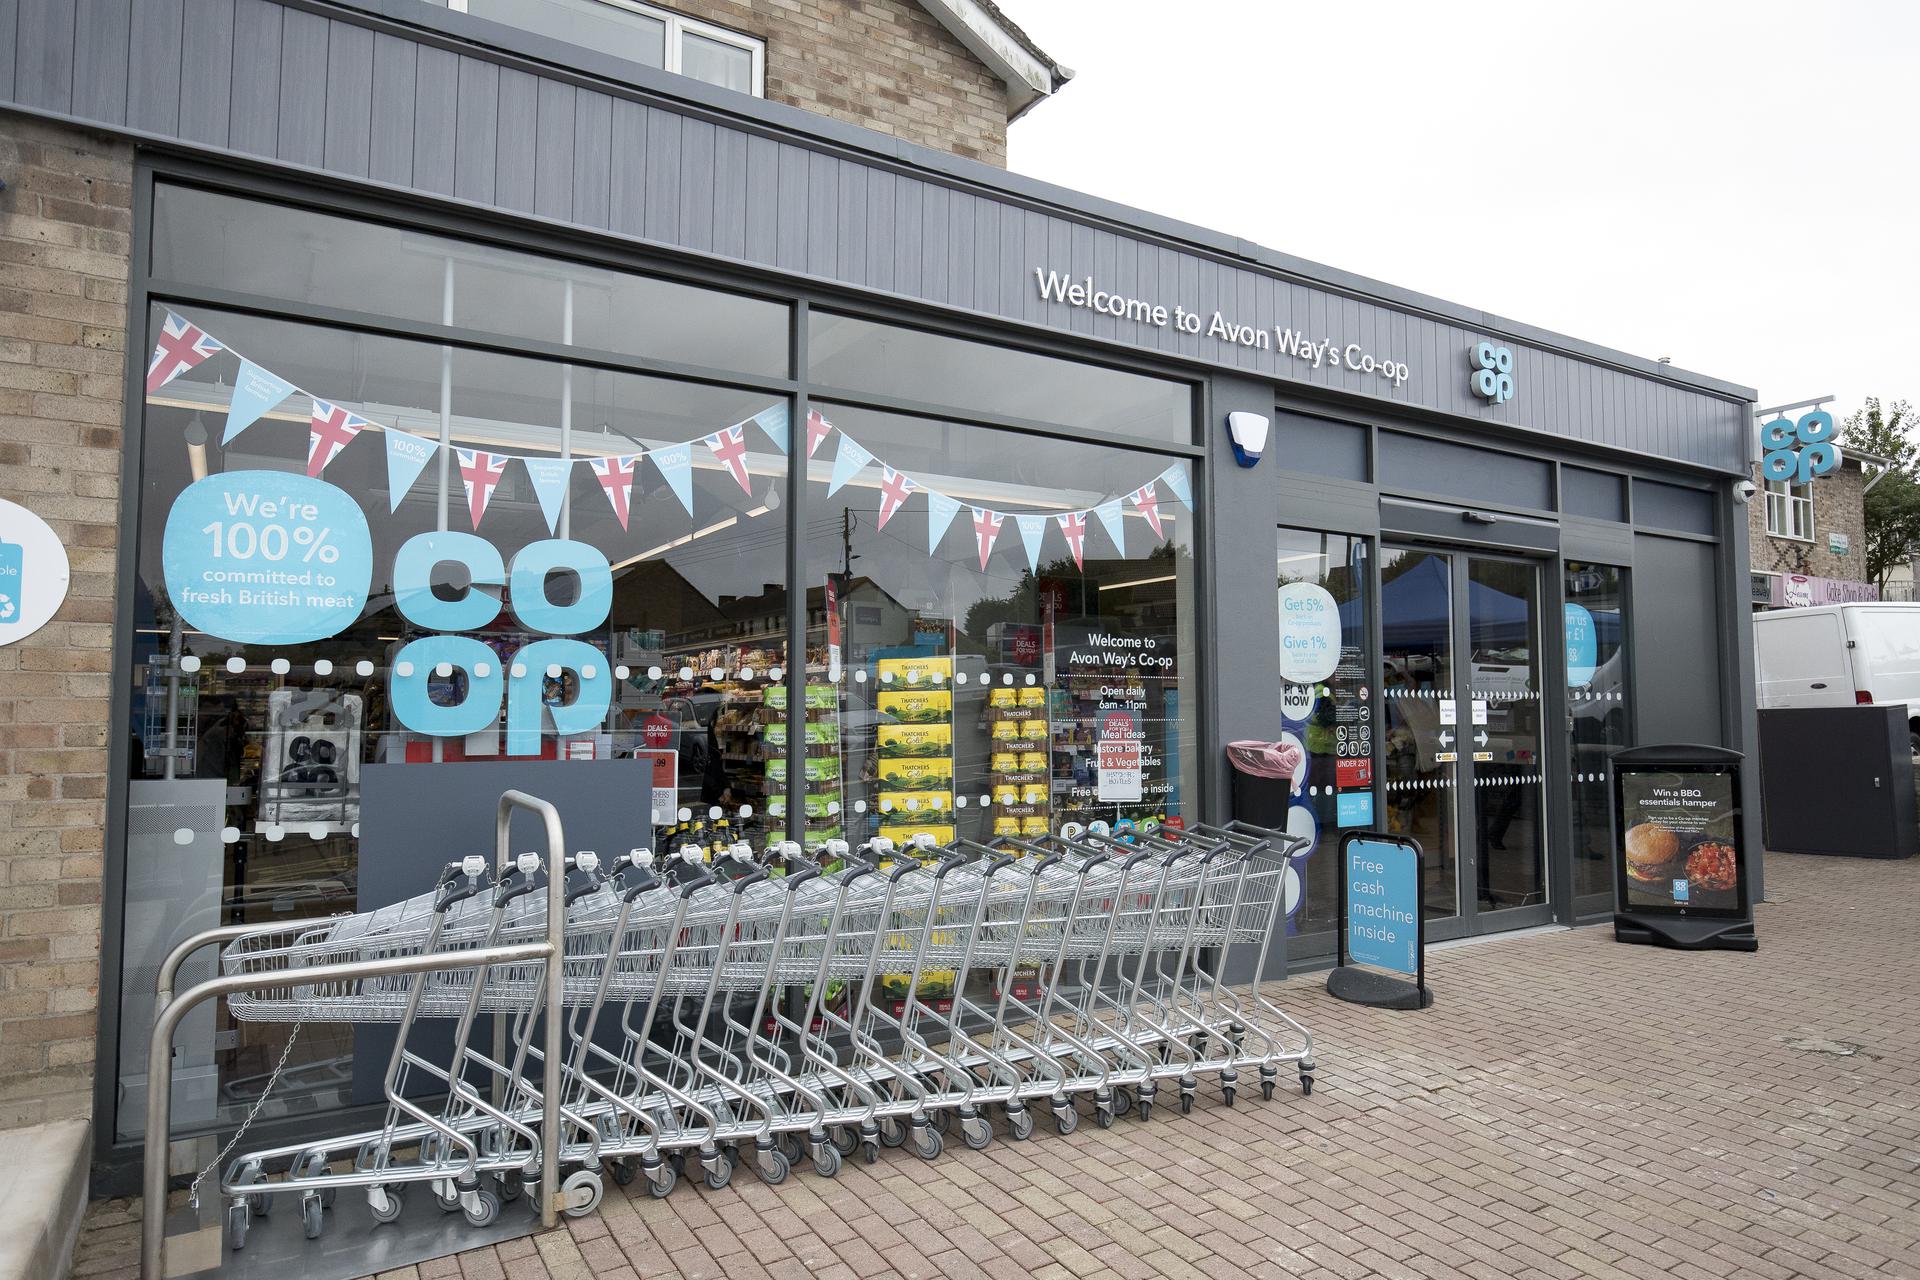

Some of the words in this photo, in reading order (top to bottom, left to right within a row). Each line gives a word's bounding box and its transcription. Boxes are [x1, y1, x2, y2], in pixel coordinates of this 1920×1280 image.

[1036, 266, 1168, 327] Welcome
[1175, 305, 1201, 334] to
[1206, 311, 1269, 350] Avon
[1275, 325, 1340, 369] Way's
[1344, 343, 1409, 387] Co-op
[394, 440, 426, 458] 100%
[223, 491, 319, 521] We're
[201, 520, 340, 564] 100%
[202, 568, 312, 587] committed
[316, 573, 336, 587] to
[181, 586, 233, 604] fresh
[239, 588, 300, 607] British
[306, 593, 355, 608] meat
[1752, 587, 1770, 600] eaway
[1284, 597, 1304, 612] Get
[1306, 598, 1324, 612] 5%
[1016, 640, 1036, 648] DEALS
[1088, 633, 1142, 648] Welcome
[1144, 637, 1156, 649] to
[1283, 635, 1308, 649] Give
[1310, 635, 1327, 649] 1%
[1069, 651, 1100, 665] Avon
[1102, 652, 1137, 669] Way's
[1138, 652, 1173, 670] Co-op
[1099, 685, 1125, 698] Open
[1126, 686, 1146, 698] daily
[1099, 700, 1118, 710] 6am
[1125, 700, 1147, 712] 11pm
[1284, 696, 1309, 706] NOW
[1003, 710, 1032, 718] THATCHERS
[647, 724, 668, 732] DEALS
[1101, 729, 1122, 739] Meal
[1124, 728, 1147, 739] ideas
[1006, 742, 1035, 750] THATCHERS
[1106, 758, 1115, 767] &
[1337, 760, 1357, 768] UNDER
[652, 790, 670, 799] CHERS
[1071, 786, 1091, 797] Free
[1150, 783, 1175, 794] inside
[1653, 788, 1671, 797] Win
[1673, 789, 1679, 797] a
[1680, 788, 1702, 798] BBQ
[1006, 806, 1035, 814] THATCHERS
[1639, 798, 1681, 807] essentials
[1682, 798, 1717, 809] hamper
[1353, 855, 1384, 874] Free
[1353, 879, 1385, 897] cash
[1353, 903, 1414, 924] machine
[1354, 921, 1396, 944] inside
